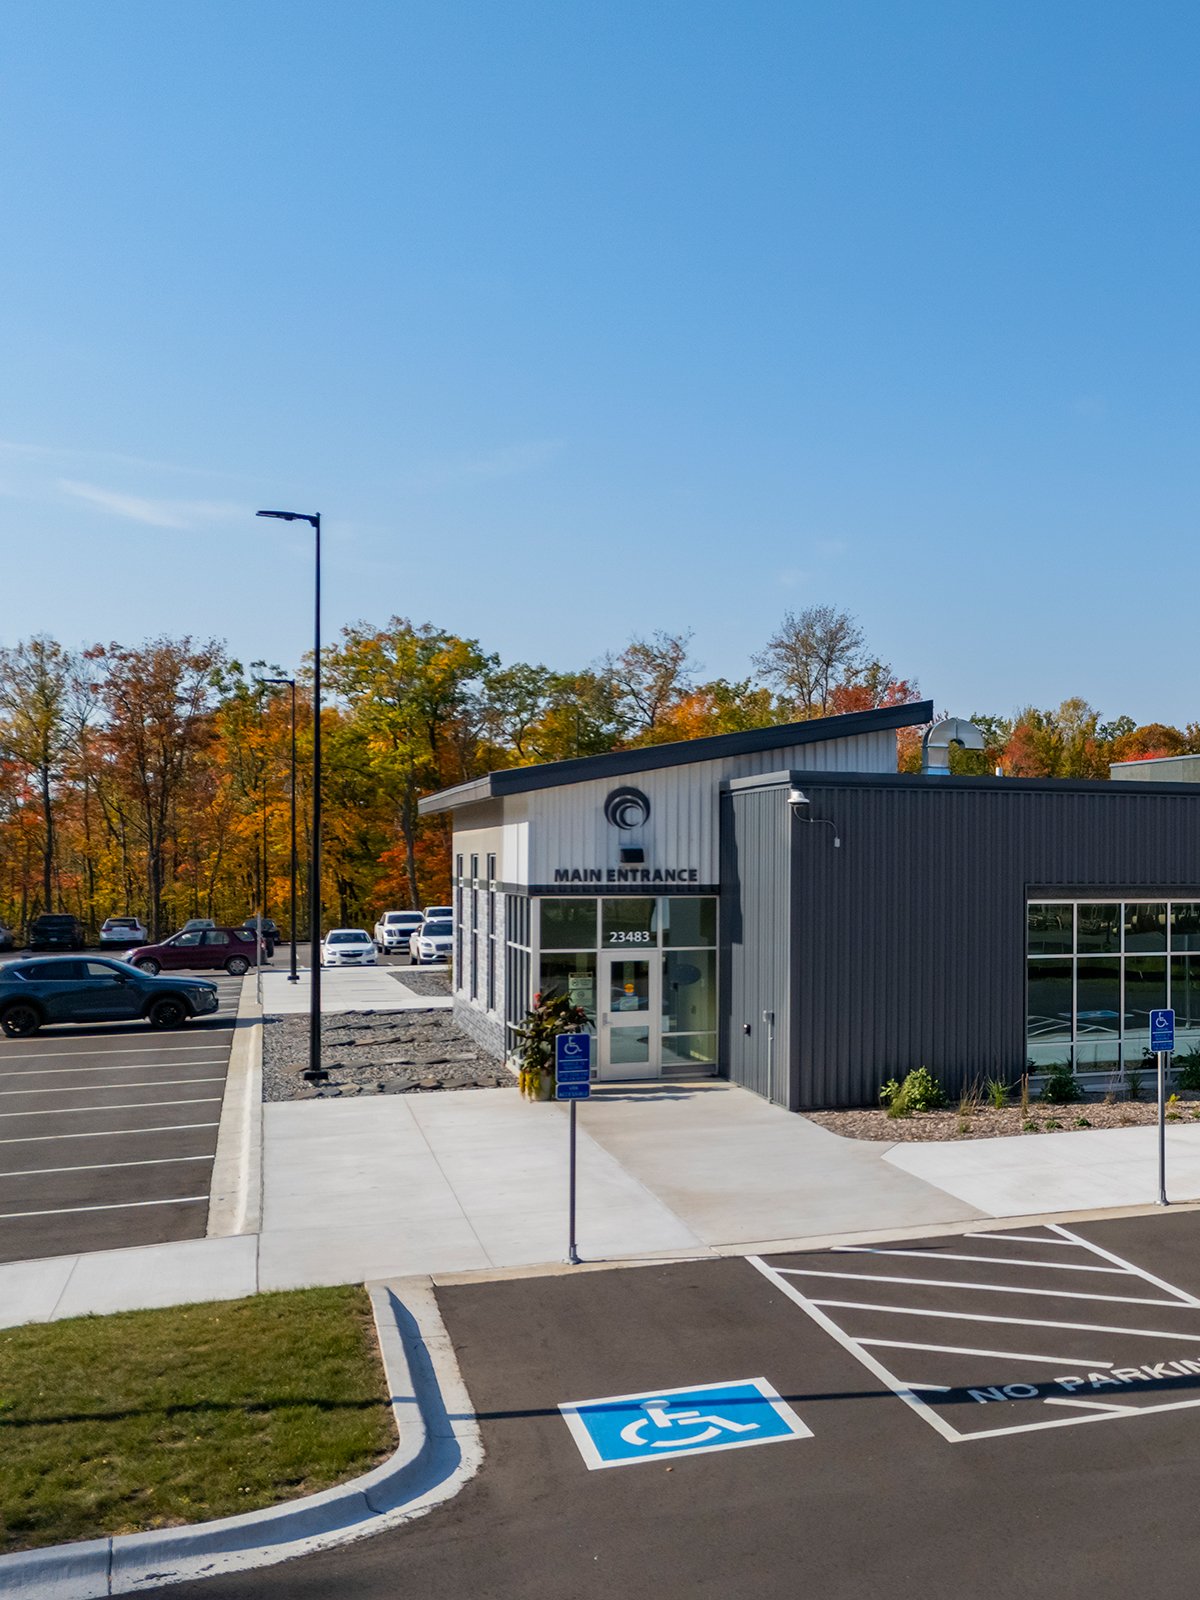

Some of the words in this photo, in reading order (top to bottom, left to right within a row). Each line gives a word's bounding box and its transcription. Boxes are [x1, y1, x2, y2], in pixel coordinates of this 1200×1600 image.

[554, 868, 601, 882] MAIN
[606, 868, 698, 882] ENTRANCE
[609, 931, 650, 943] 23483
[967, 1382, 1039, 1404] NO
